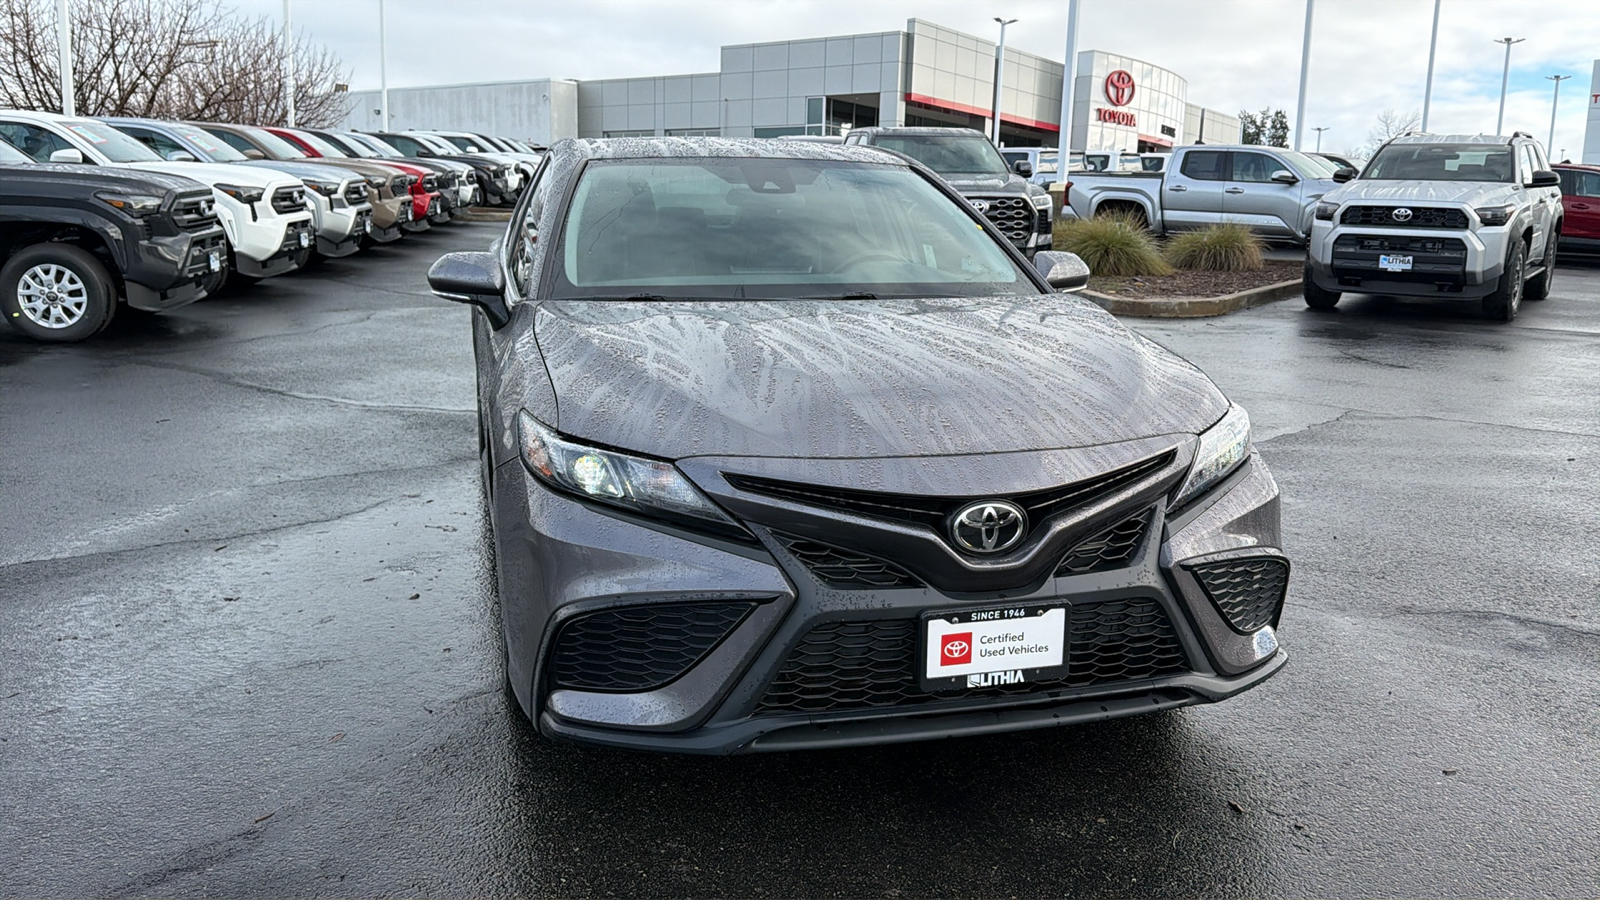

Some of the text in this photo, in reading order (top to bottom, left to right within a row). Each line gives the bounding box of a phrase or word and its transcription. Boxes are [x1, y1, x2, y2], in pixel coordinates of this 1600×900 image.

[1096, 108, 1136, 127] TOYOTA
[1387, 257, 1411, 265] LITHIA
[971, 608, 1025, 621] SINCE 1946
[980, 632, 1024, 645] Certified
[980, 644, 1049, 658] Used Vehicles
[980, 670, 1025, 687] LITHIA
